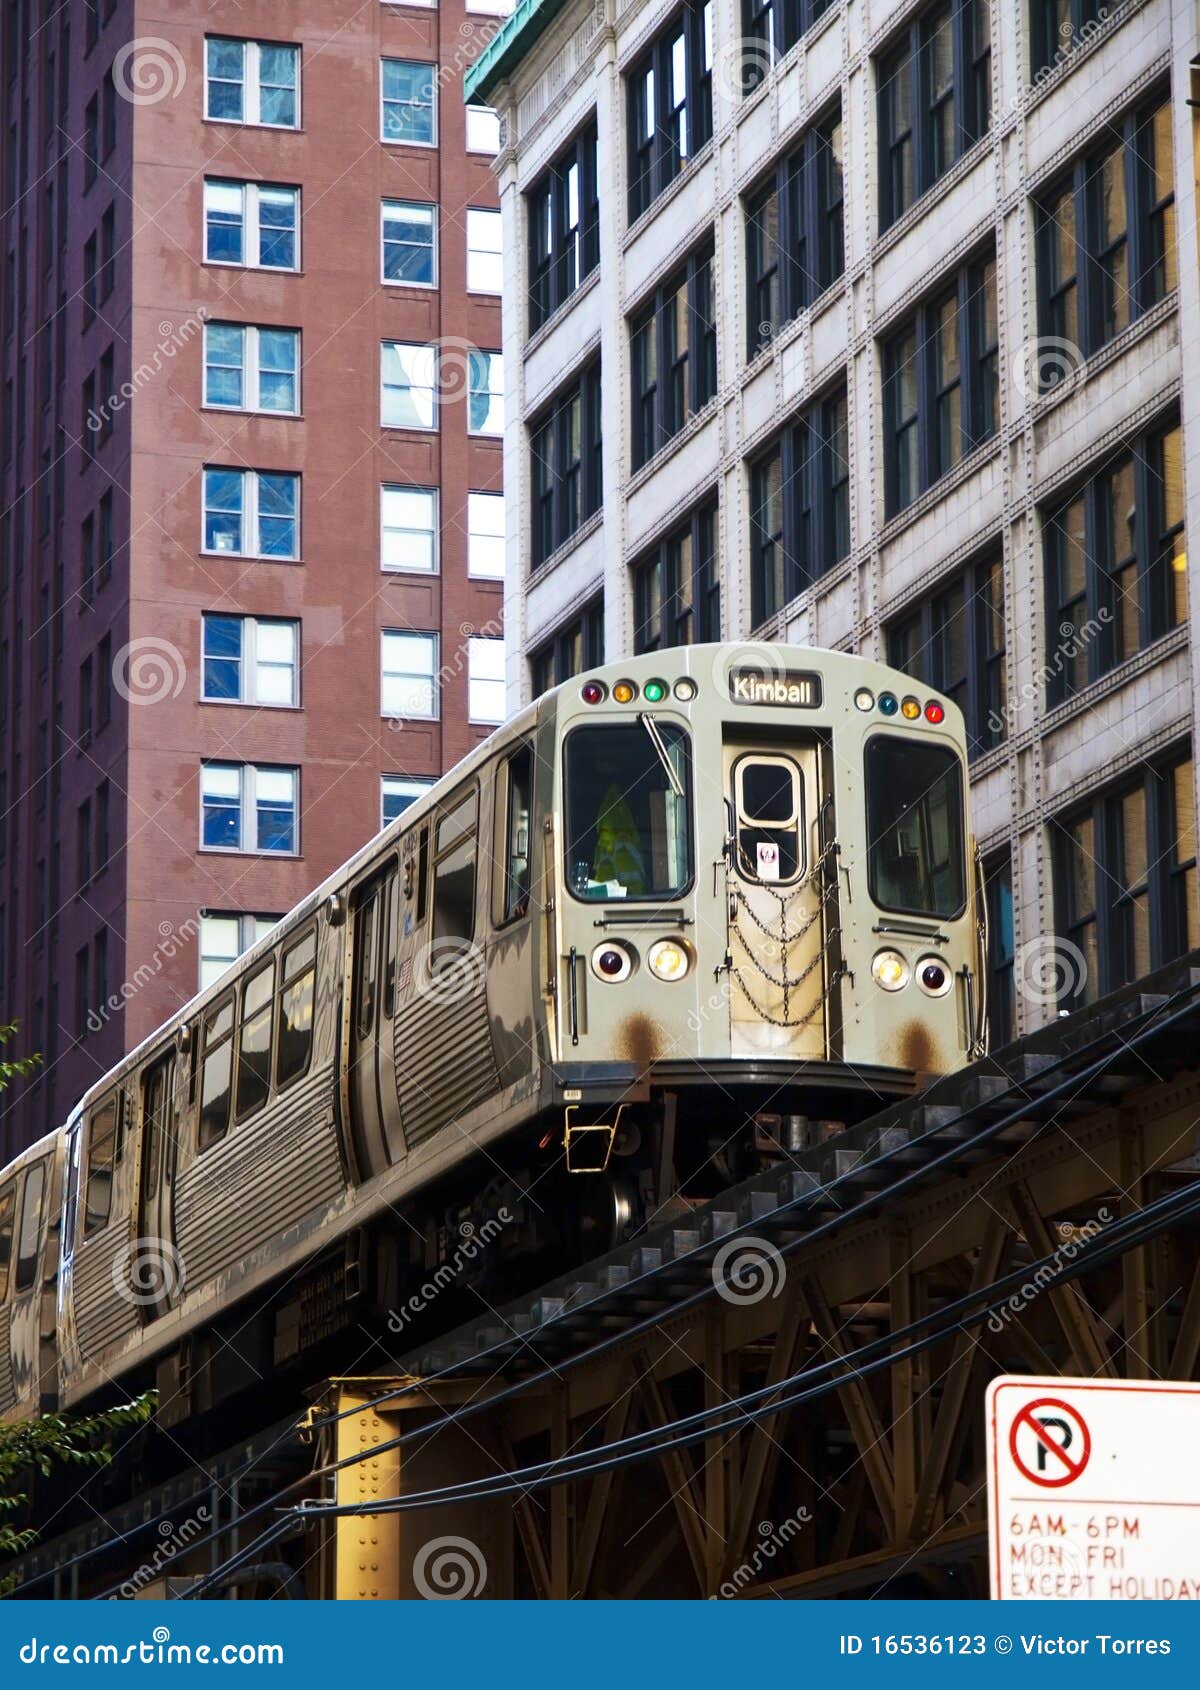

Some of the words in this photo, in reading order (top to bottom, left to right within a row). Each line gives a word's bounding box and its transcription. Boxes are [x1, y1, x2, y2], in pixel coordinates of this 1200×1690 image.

[734, 676, 811, 703] Kimball
[1010, 1572, 1095, 1599] EXCEPT
[1109, 1575, 1200, 1600] HOLIDAY
